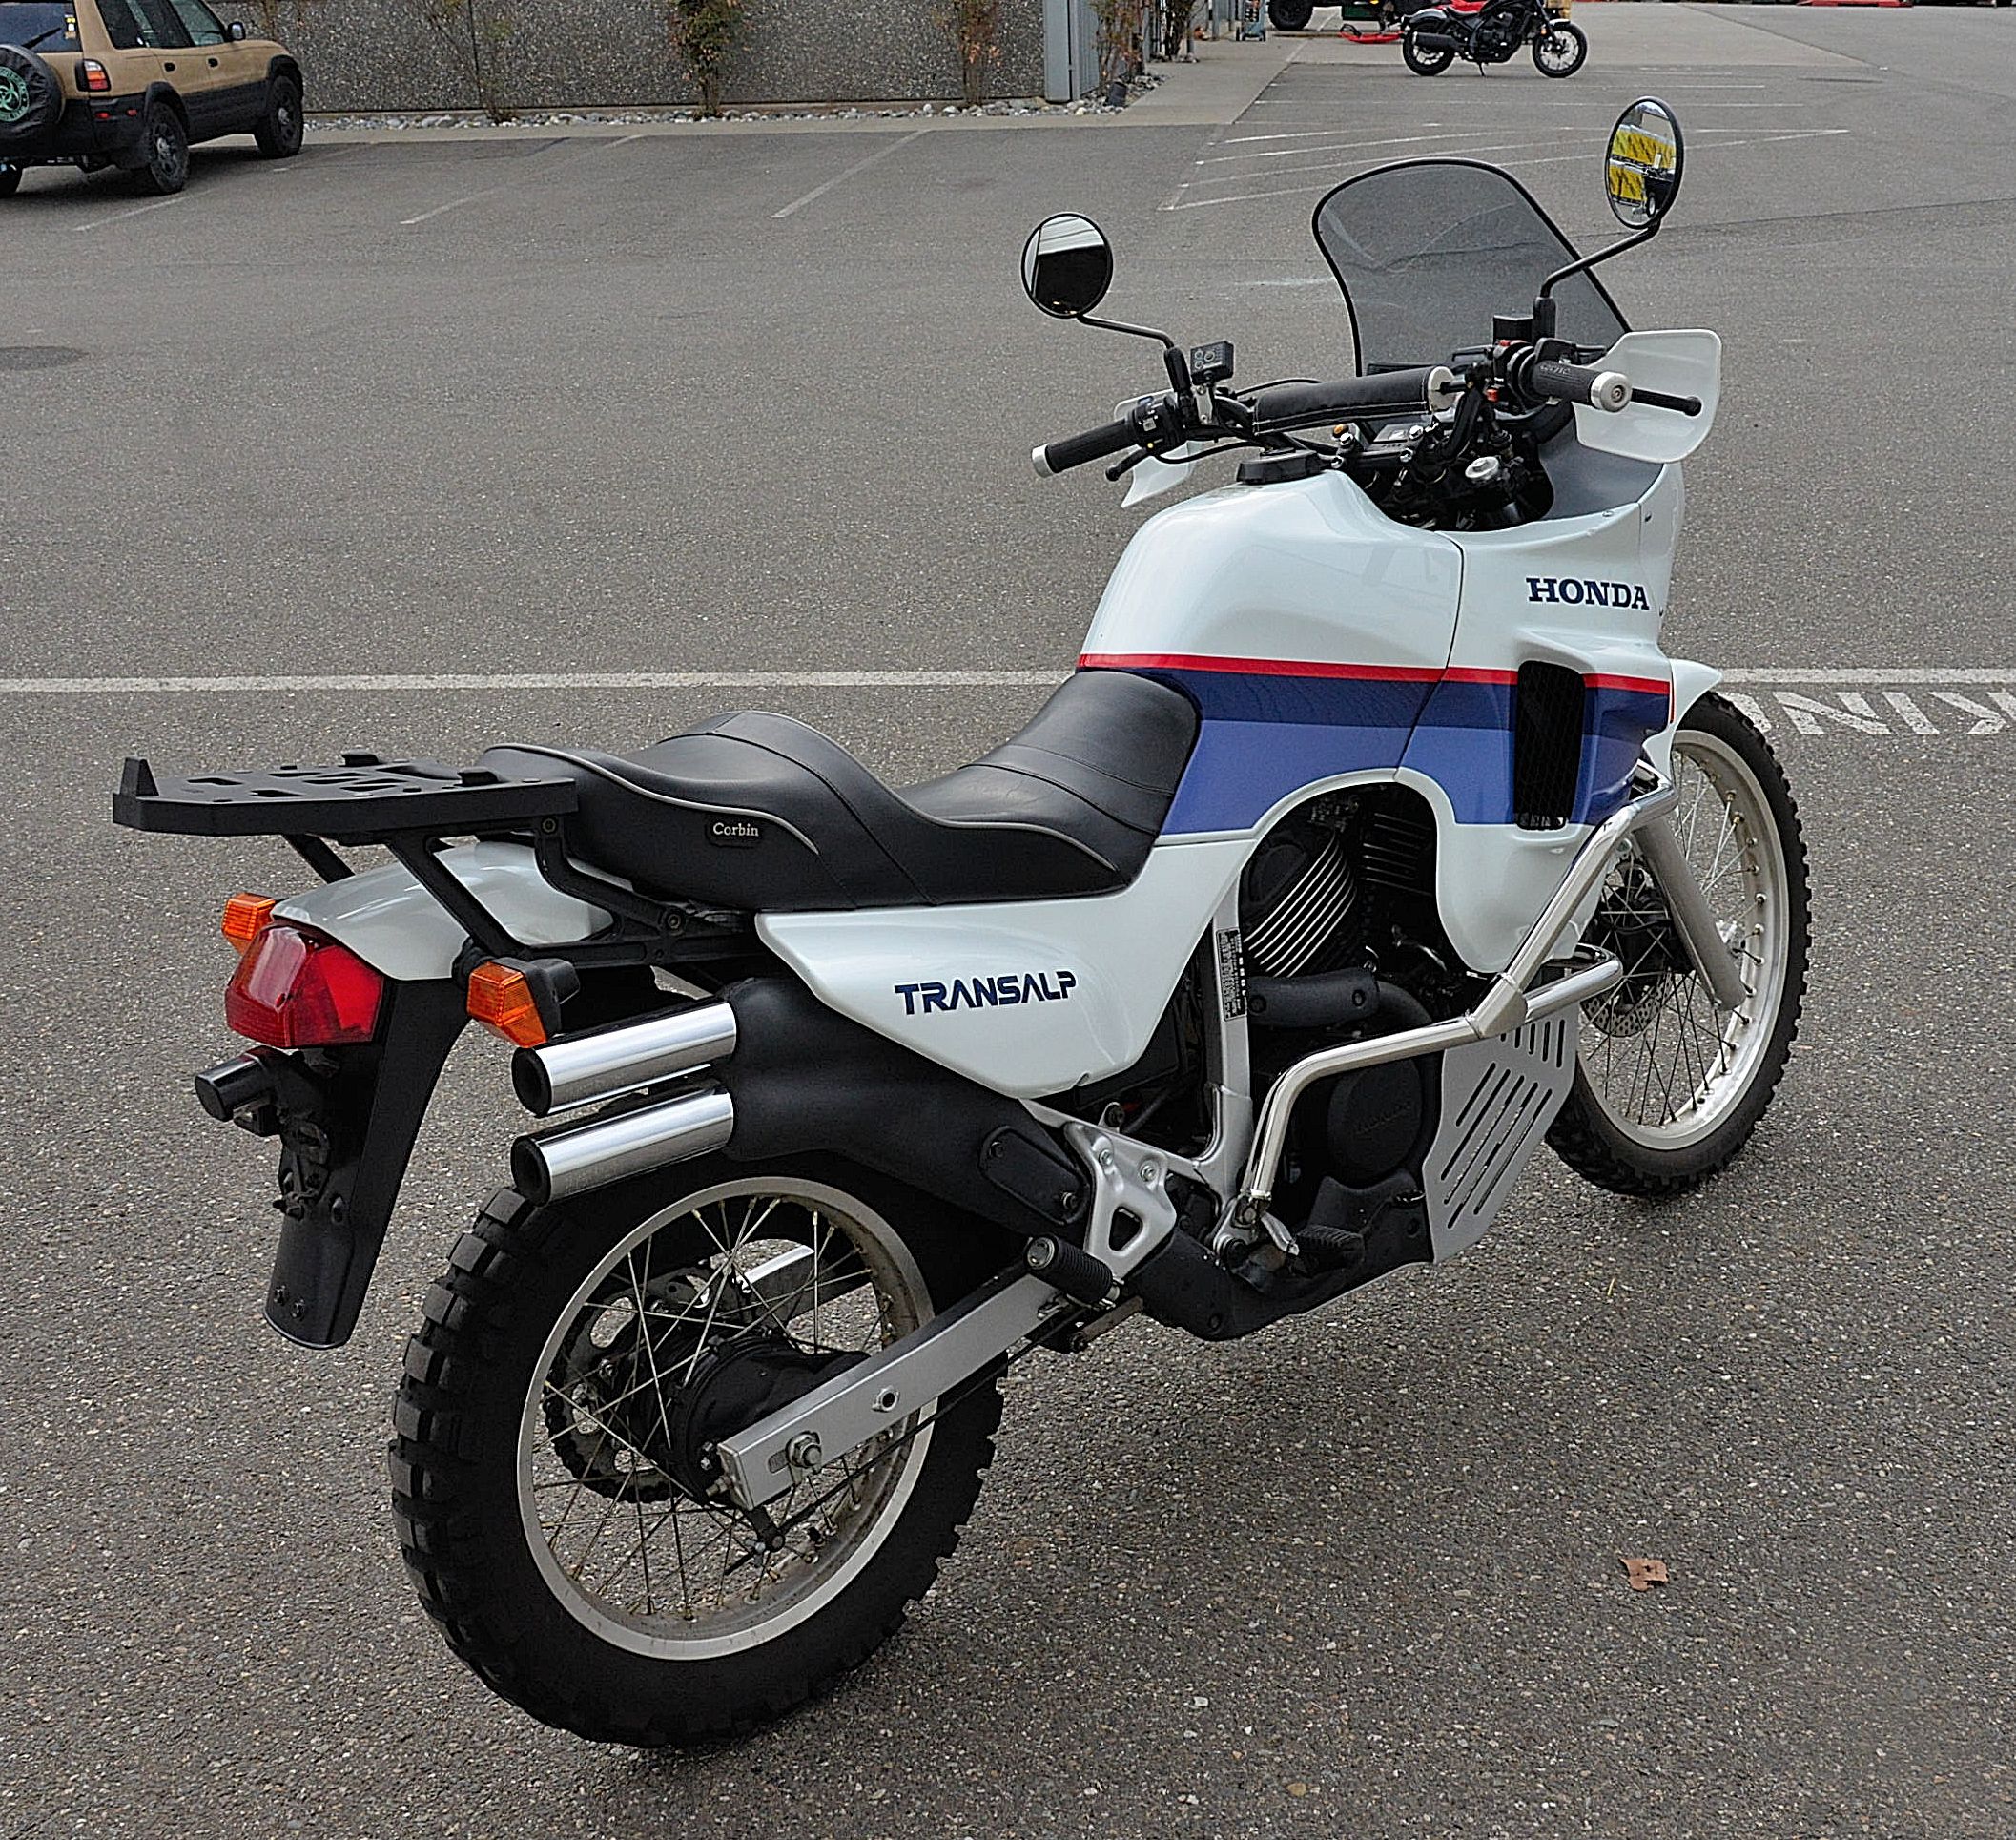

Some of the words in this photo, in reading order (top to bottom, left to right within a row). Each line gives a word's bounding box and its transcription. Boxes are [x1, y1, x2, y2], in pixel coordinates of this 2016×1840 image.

[1526, 577, 1650, 610] HONDA
[713, 821, 759, 837] Corbin
[895, 970, 1077, 1015] TRANSALP
